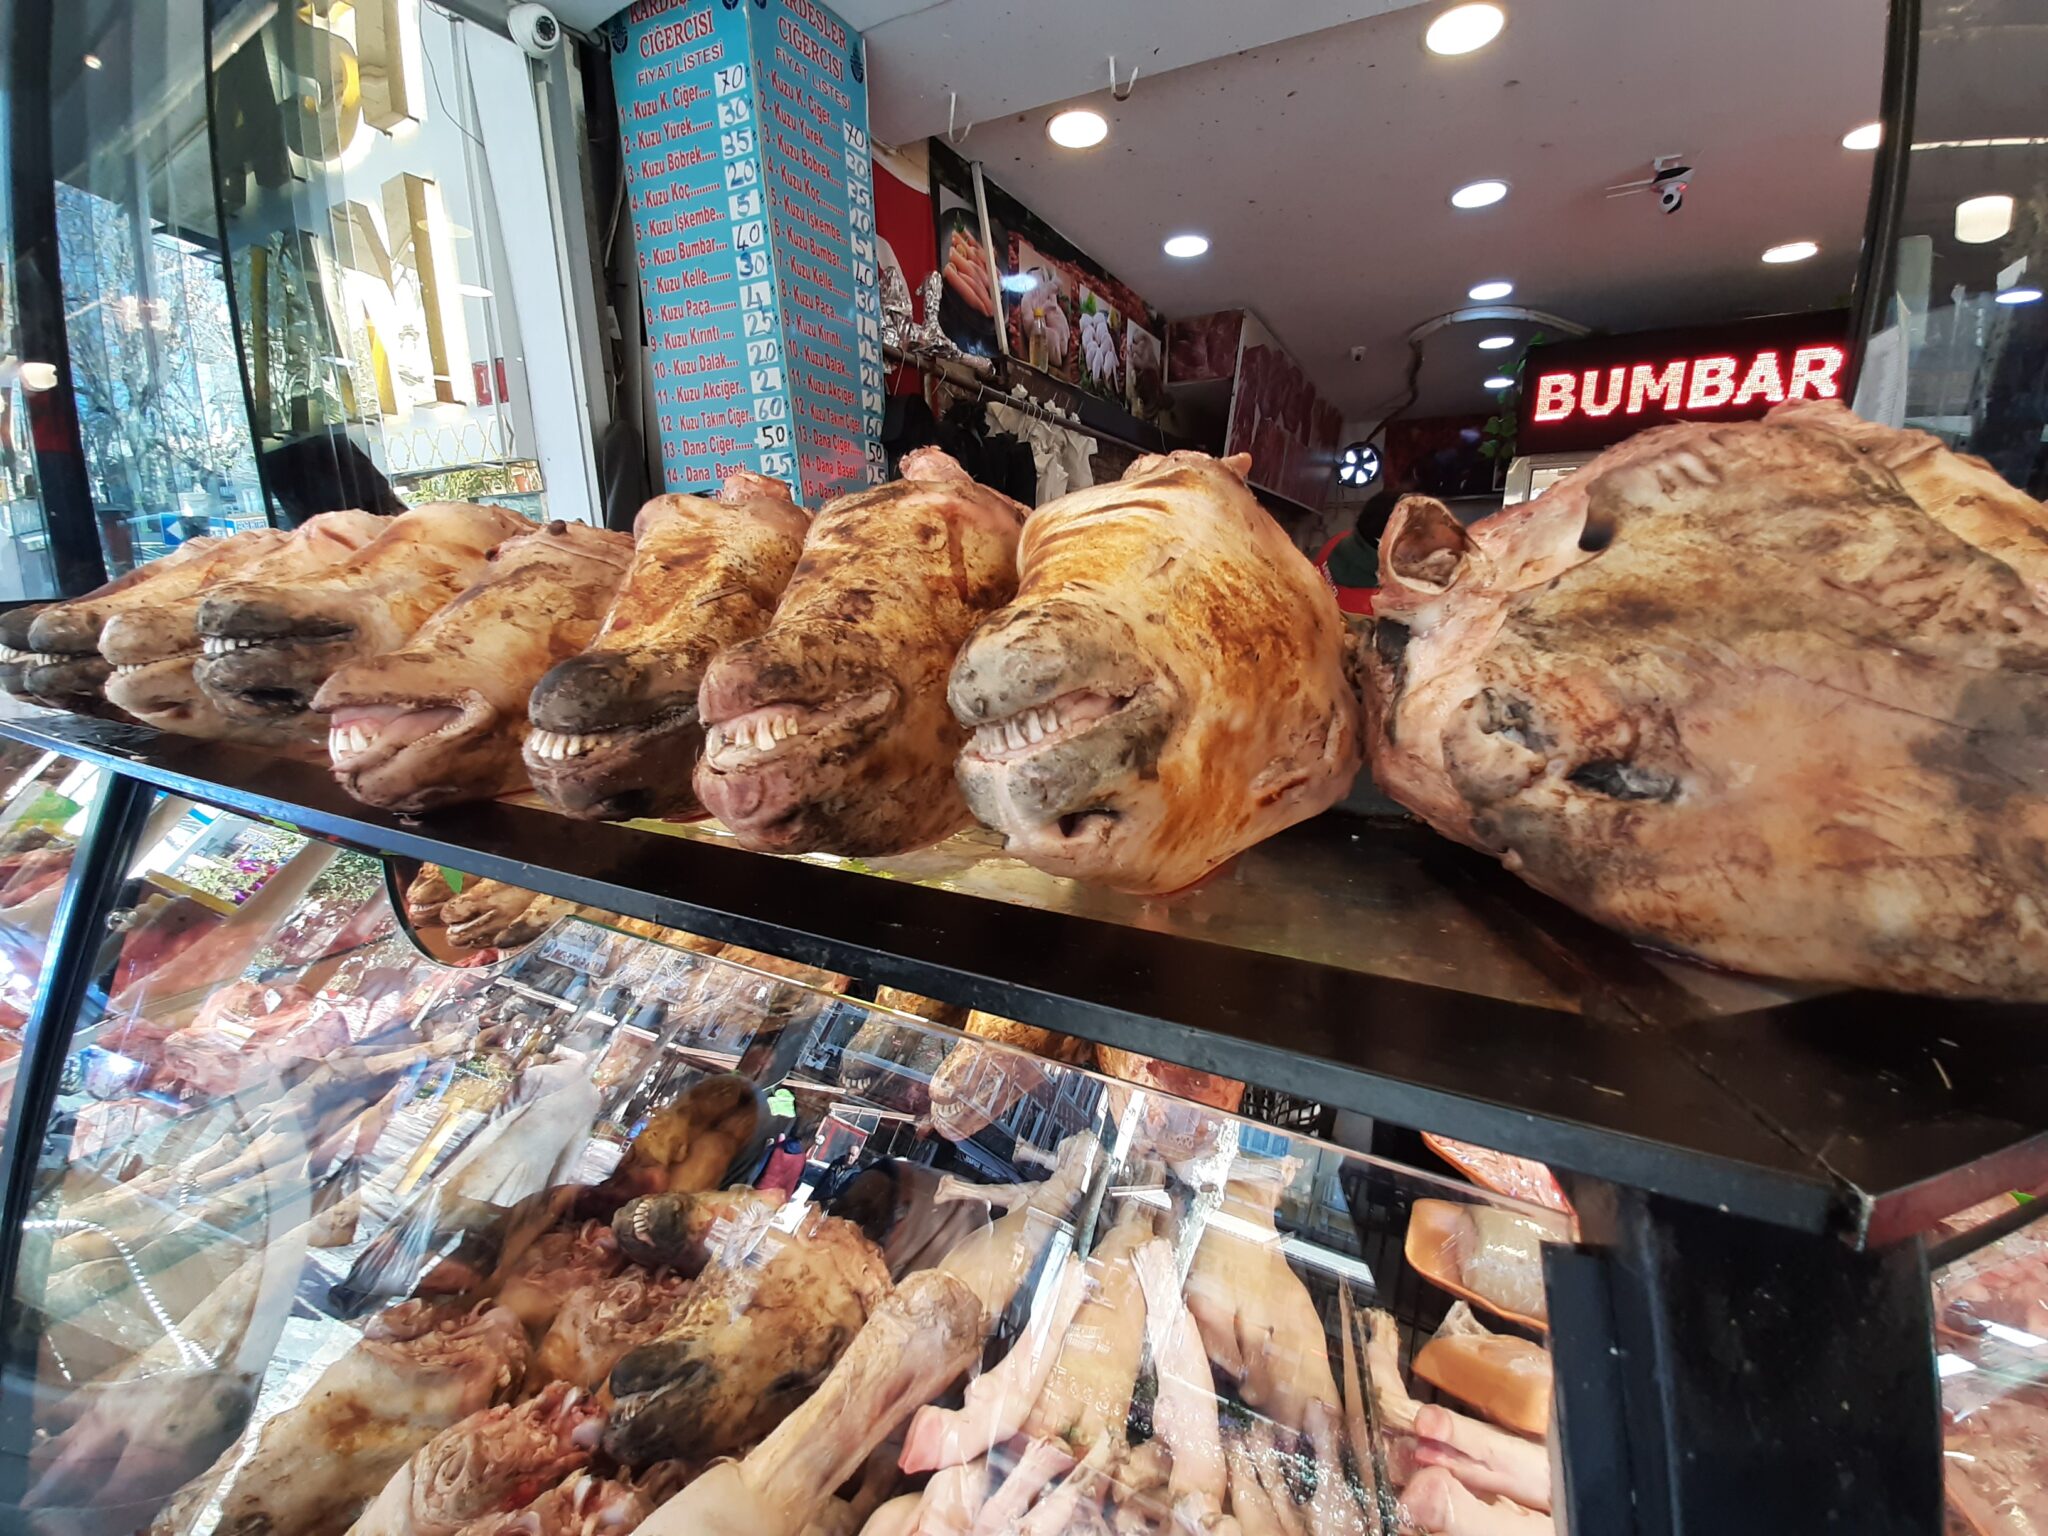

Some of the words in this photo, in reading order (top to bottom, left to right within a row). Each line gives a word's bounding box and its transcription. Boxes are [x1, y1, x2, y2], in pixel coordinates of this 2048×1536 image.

[640, 6, 714, 58] CİĞERCİSİ
[638, 63, 672, 86] FİYAT
[676, 40, 723, 73] LİSTESİ
[634, 99, 657, 120] Kuzu
[718, 65, 742, 94] 70
[771, 69, 793, 99] Kuzu
[845, 121, 865, 148] 70
[774, 101, 796, 131] Kuzu
[638, 131, 661, 149] Kuzu
[777, 133, 799, 161] Kuzu
[641, 161, 664, 179] Kuzu
[781, 163, 802, 192] Kuzu
[645, 190, 668, 208] Kuzu
[784, 195, 805, 222] Kuzu
[649, 220, 672, 237] Kuzu
[737, 193, 749, 216] 5
[653, 248, 676, 266] Kuzu
[737, 224, 760, 251] 40
[787, 225, 807, 250] Kuzu
[856, 262, 874, 288] 40
[656, 277, 680, 294] Kuzu
[740, 253, 765, 276] 30
[790, 255, 810, 280] Kuzu
[660, 305, 684, 322] Kuzu
[747, 286, 762, 311] 4
[793, 285, 813, 309] Kuzu
[796, 314, 817, 337] Kuzu
[664, 333, 687, 349] Kuzu
[804, 345, 823, 367] Kuzu
[673, 360, 696, 376] Kuzu
[750, 342, 776, 364] 20
[677, 386, 700, 403] Kuzu
[757, 370, 777, 391] 2
[808, 374, 826, 394] Kuzu
[1533, 347, 1843, 422] BUMBAR
[680, 415, 699, 431] Kuzu
[701, 411, 726, 428] Takım
[758, 398, 782, 420] 60
[683, 439, 706, 455] Dana
[762, 425, 785, 449] 50
[813, 427, 831, 448] Dana
[870, 442, 882, 462] 50
[686, 465, 710, 482] Dana
[765, 453, 793, 476] 25
[816, 456, 833, 476] Dana
